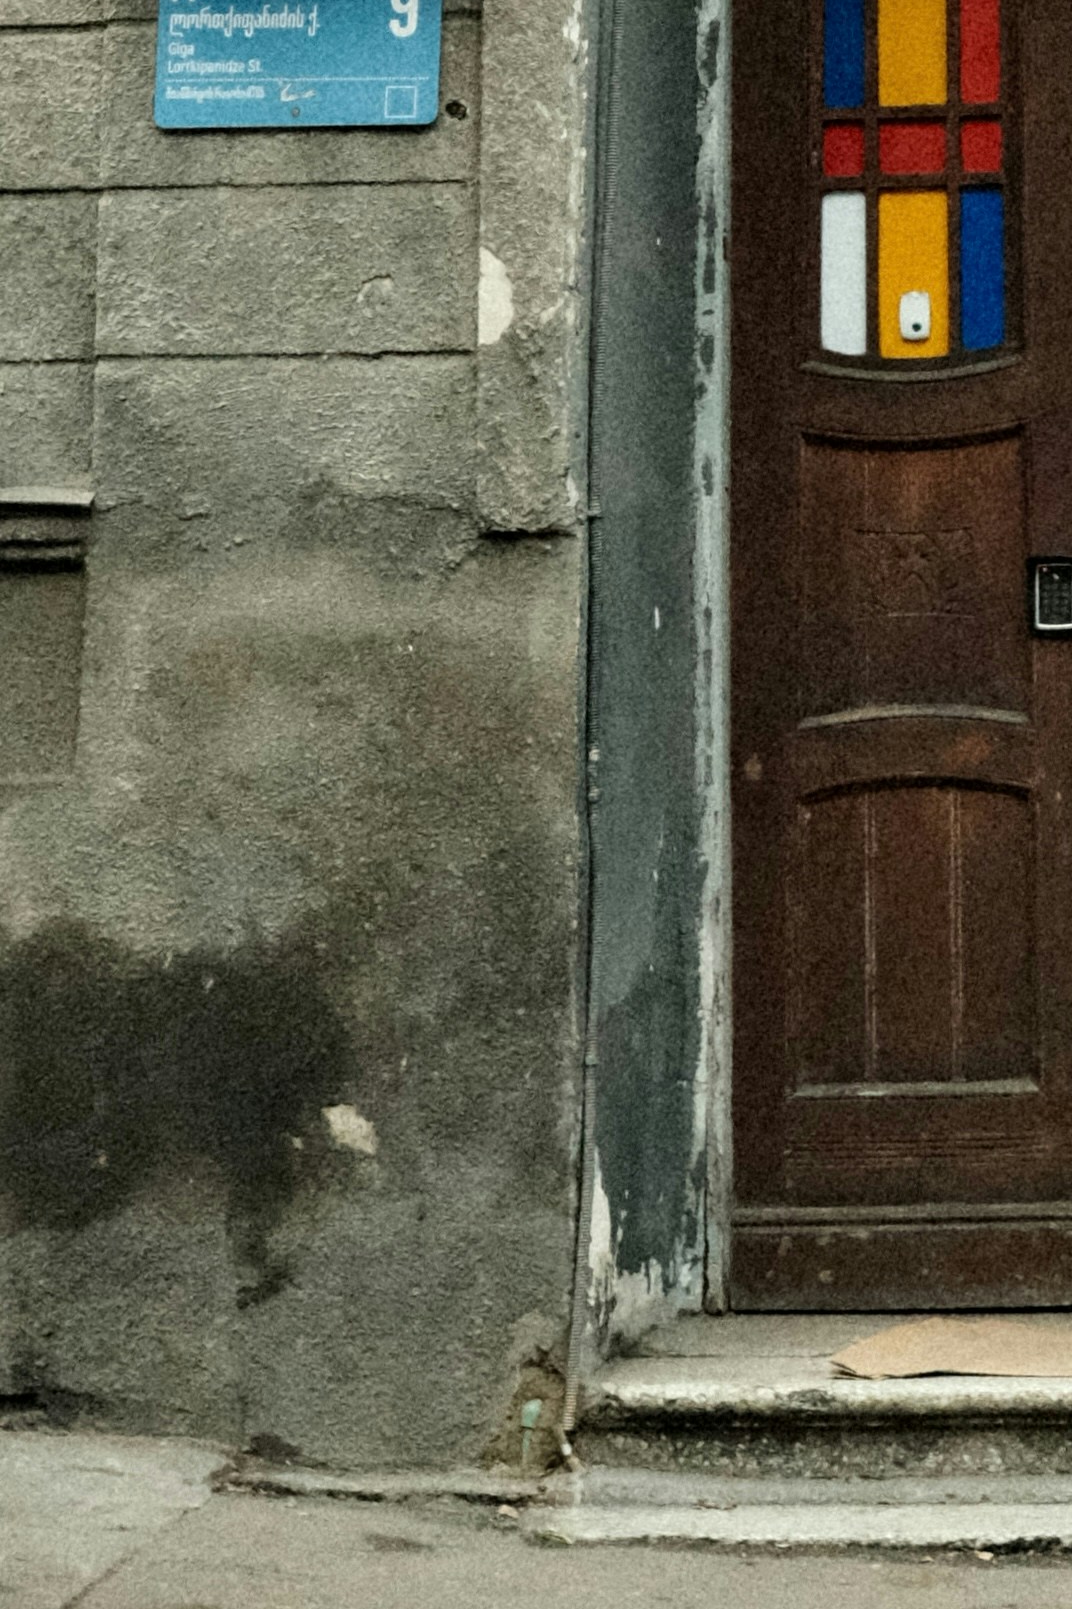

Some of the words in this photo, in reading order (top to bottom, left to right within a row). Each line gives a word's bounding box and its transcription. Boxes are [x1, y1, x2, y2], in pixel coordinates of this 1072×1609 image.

[169, 4, 305, 38] ლორთქიფანიძის
[168, 42, 195, 58] Giga
[247, 58, 263, 73] St.
